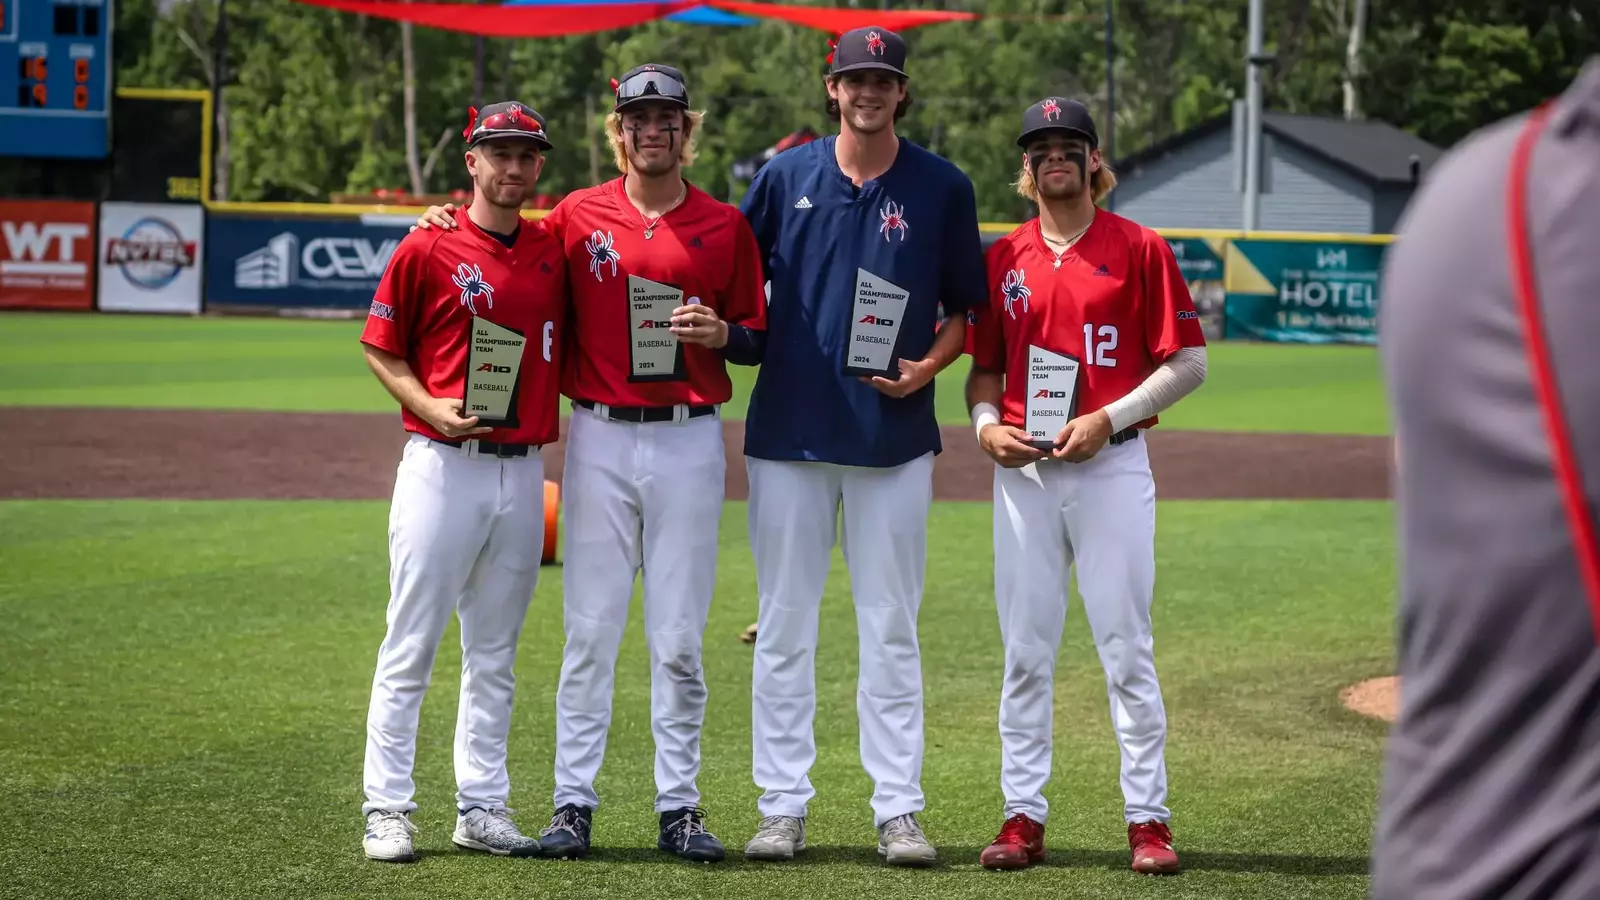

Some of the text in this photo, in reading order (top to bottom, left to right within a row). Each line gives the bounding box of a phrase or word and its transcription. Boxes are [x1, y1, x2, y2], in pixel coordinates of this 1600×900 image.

[2, 221, 89, 261] WT
[633, 294, 680, 302] CHAMPIONSHIP
[859, 289, 906, 301] CHAMPIONSHIP
[1280, 281, 1380, 308] HOTEL
[858, 314, 894, 327] A10
[475, 329, 489, 337] ALL
[475, 338, 523, 347] CHAMPIONSHIP
[637, 340, 673, 348] BASEBALL
[856, 335, 891, 345] BASEBALL
[1083, 323, 1118, 367] 12
[853, 355, 870, 363] 2024
[476, 363, 511, 374] A10
[473, 383, 509, 393] BASEBALL
[1033, 389, 1066, 398] A10
[471, 404, 488, 412] 2024
